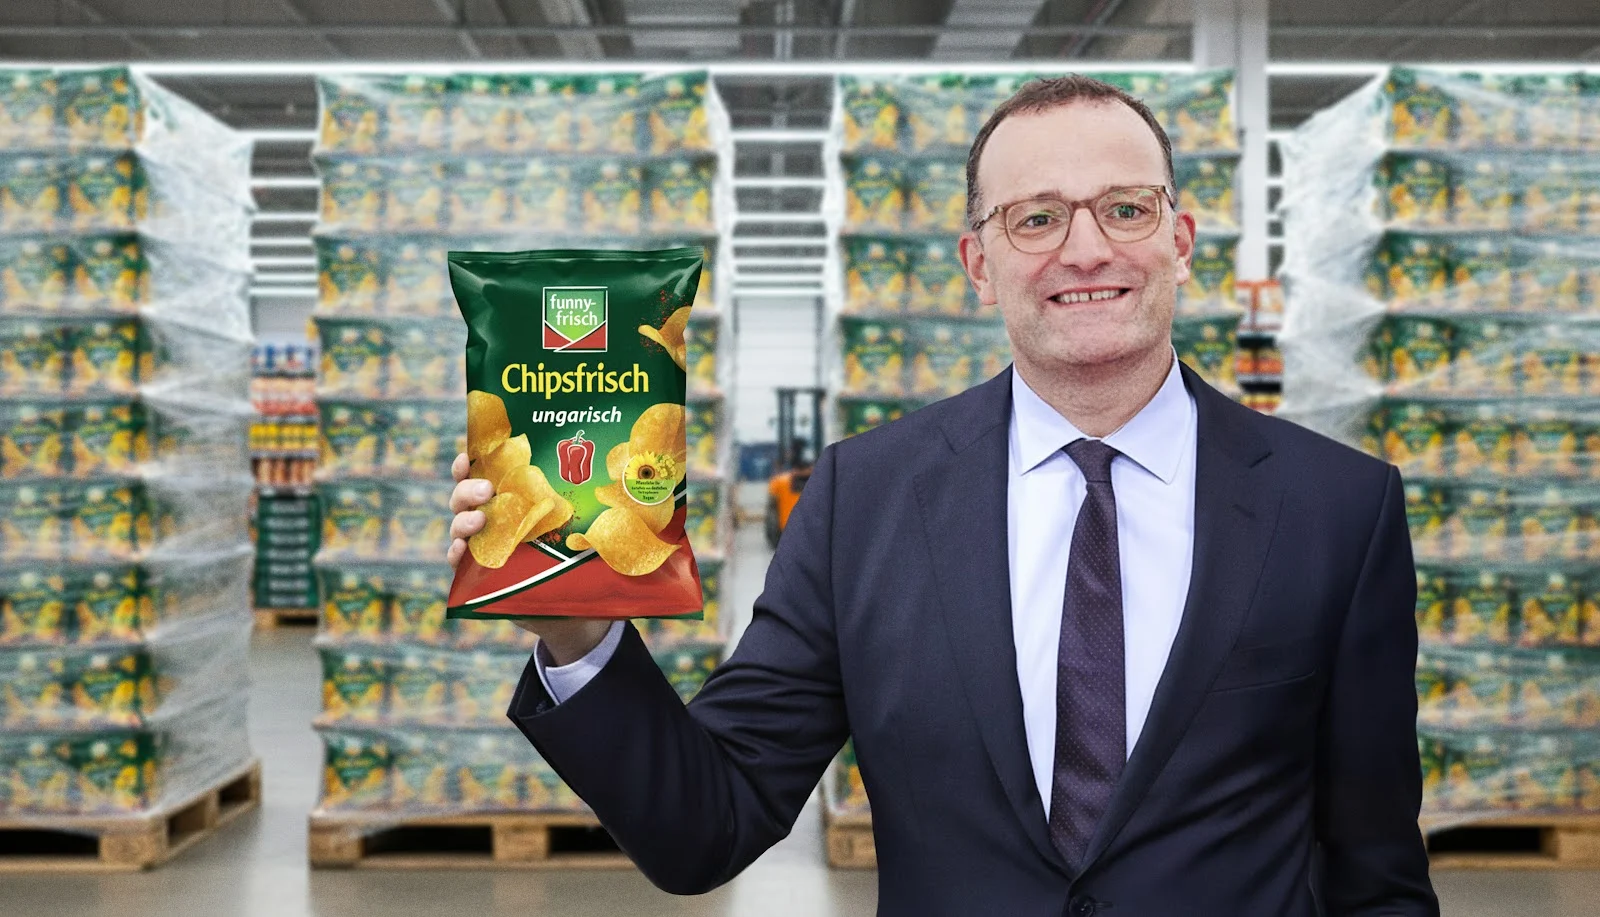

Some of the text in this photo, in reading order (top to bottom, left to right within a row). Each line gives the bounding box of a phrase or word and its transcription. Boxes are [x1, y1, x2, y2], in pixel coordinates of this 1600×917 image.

[549, 294, 597, 312] funny-
[556, 311, 598, 326] frisch
[501, 362, 650, 400] Chipsfrisch
[532, 405, 622, 427] ungarisch
